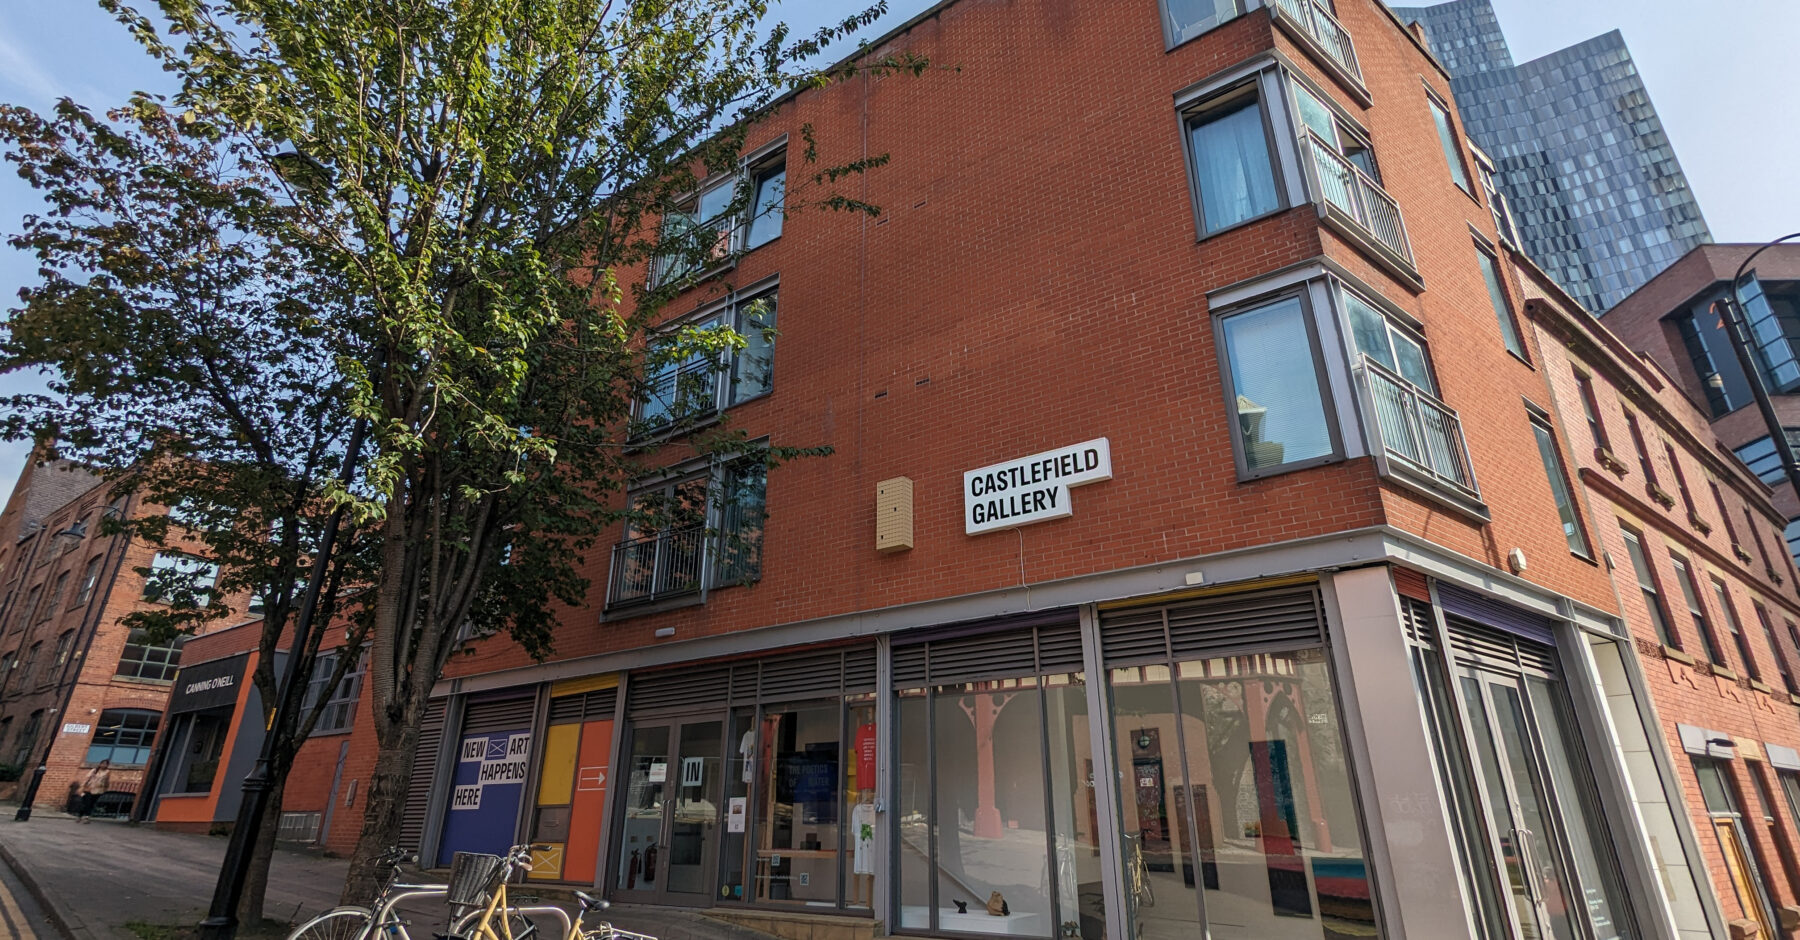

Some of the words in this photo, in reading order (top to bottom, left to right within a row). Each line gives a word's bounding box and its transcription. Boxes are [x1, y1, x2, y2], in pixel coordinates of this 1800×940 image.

[971, 449, 1099, 497] CASTLEFIELD
[972, 486, 1059, 525] GALLERY
[185, 680, 212, 695] CANNING
[211, 675, 234, 689] O'NEILL
[463, 740, 486, 758] NEW
[509, 737, 529, 755] ART
[480, 762, 526, 781] HAPPENS
[685, 761, 700, 783] IN
[788, 765, 801, 776] THE
[802, 763, 828, 775] POETICS
[808, 777, 830, 787] ATER
[454, 788, 480, 806] HERE
